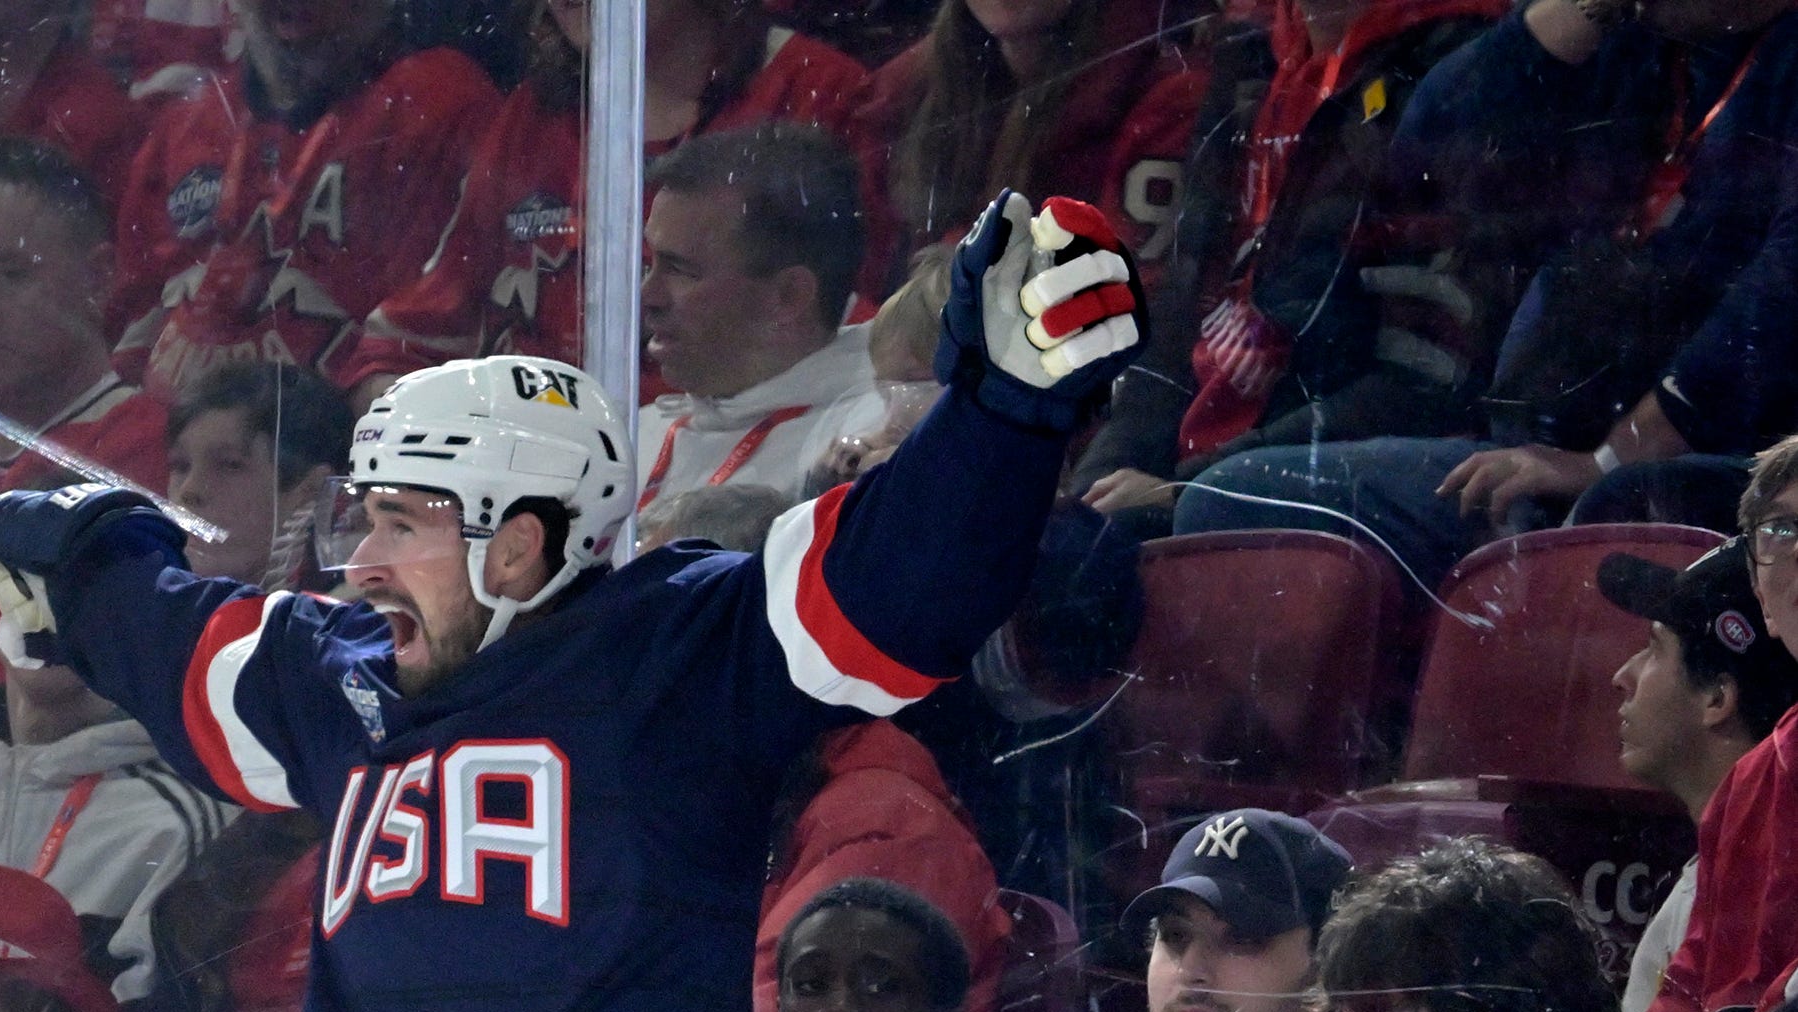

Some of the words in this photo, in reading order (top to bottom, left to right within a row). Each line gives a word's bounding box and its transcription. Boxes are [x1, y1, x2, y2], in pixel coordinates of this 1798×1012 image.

[298, 161, 344, 244] A
[511, 365, 580, 410] CAT
[355, 429, 384, 443] CCM
[321, 737, 571, 941] USA
[1193, 815, 1250, 860] NY
